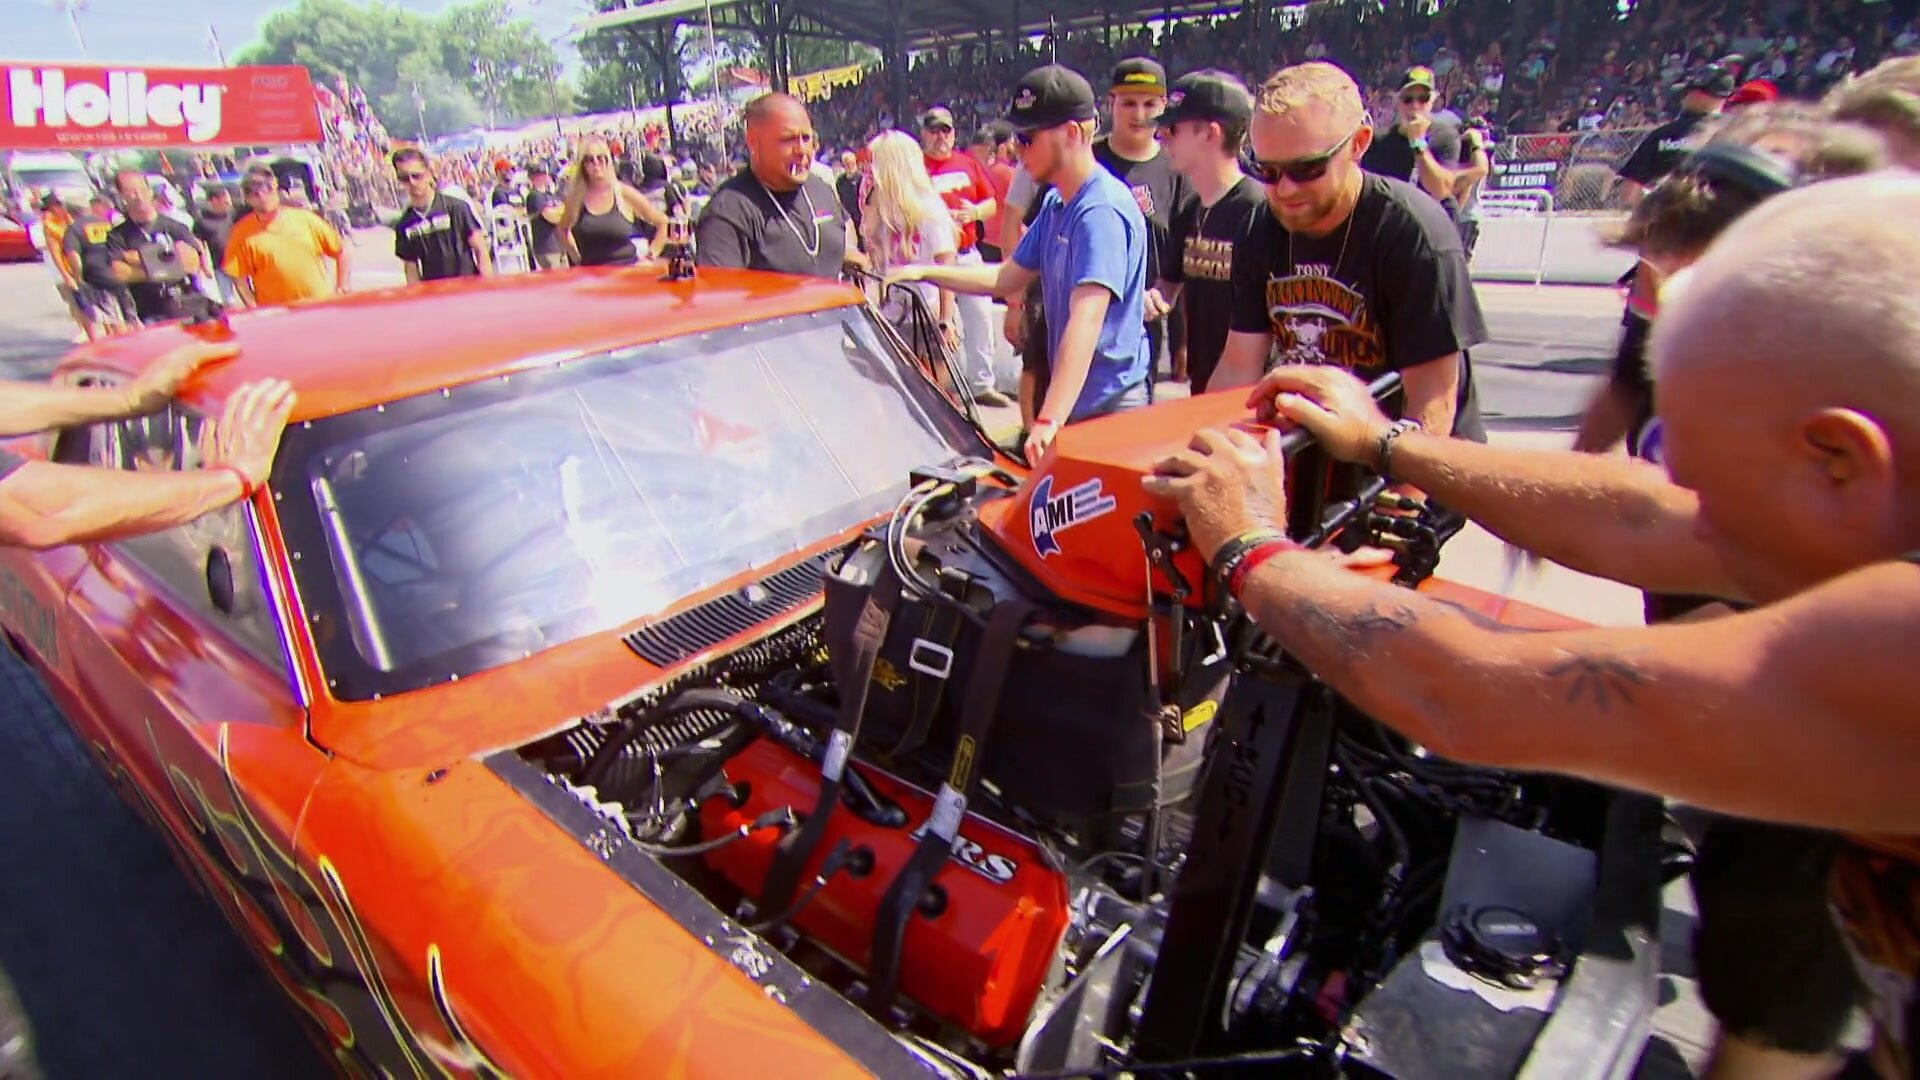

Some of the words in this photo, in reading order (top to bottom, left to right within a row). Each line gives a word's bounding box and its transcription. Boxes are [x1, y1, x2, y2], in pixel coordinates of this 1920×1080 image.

[8, 68, 223, 142] Holley
[1295, 264, 1331, 277] TONY
[1034, 494, 1075, 538] AMI
[908, 818, 1018, 884] RS
